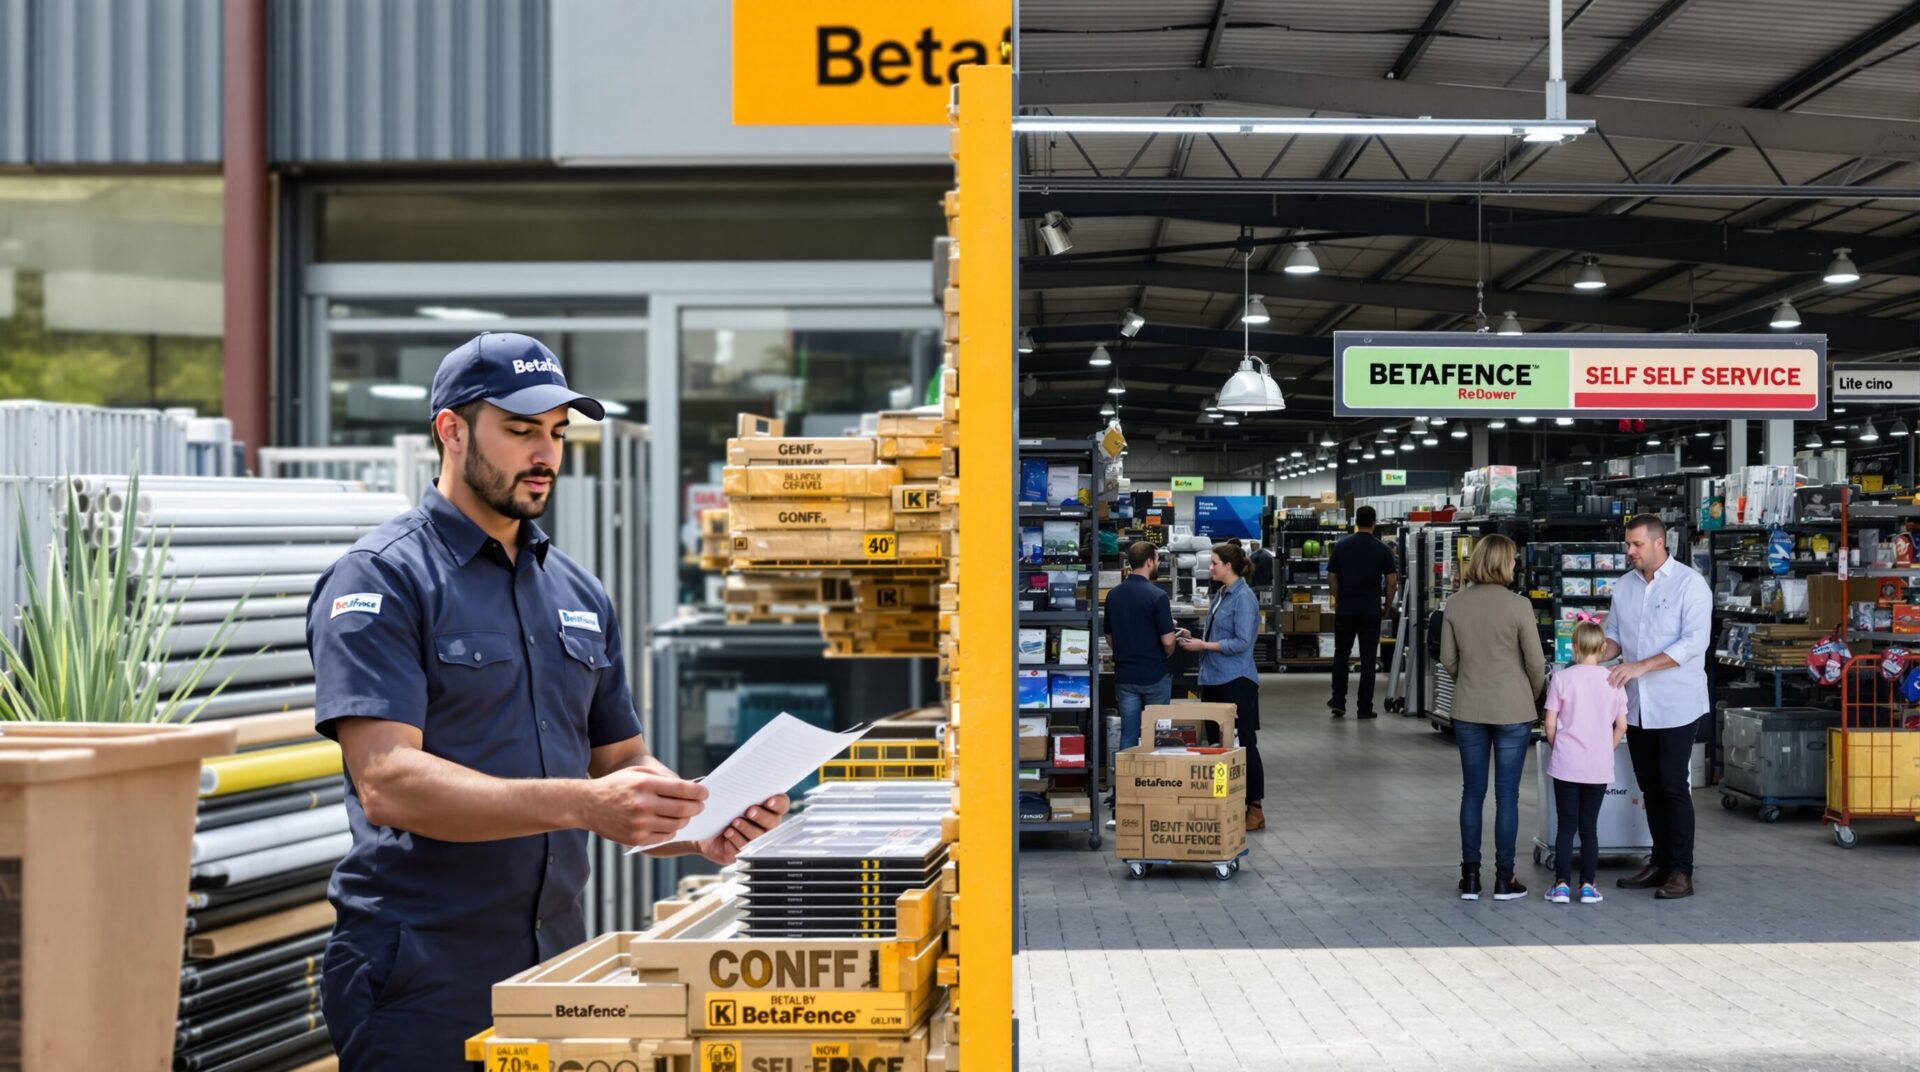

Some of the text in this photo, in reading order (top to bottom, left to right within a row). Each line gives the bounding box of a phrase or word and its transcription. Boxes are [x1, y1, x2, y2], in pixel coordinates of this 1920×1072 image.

[1586, 366, 1801, 386] SELF SELF SERVICE
[709, 949, 859, 989] CONFF
